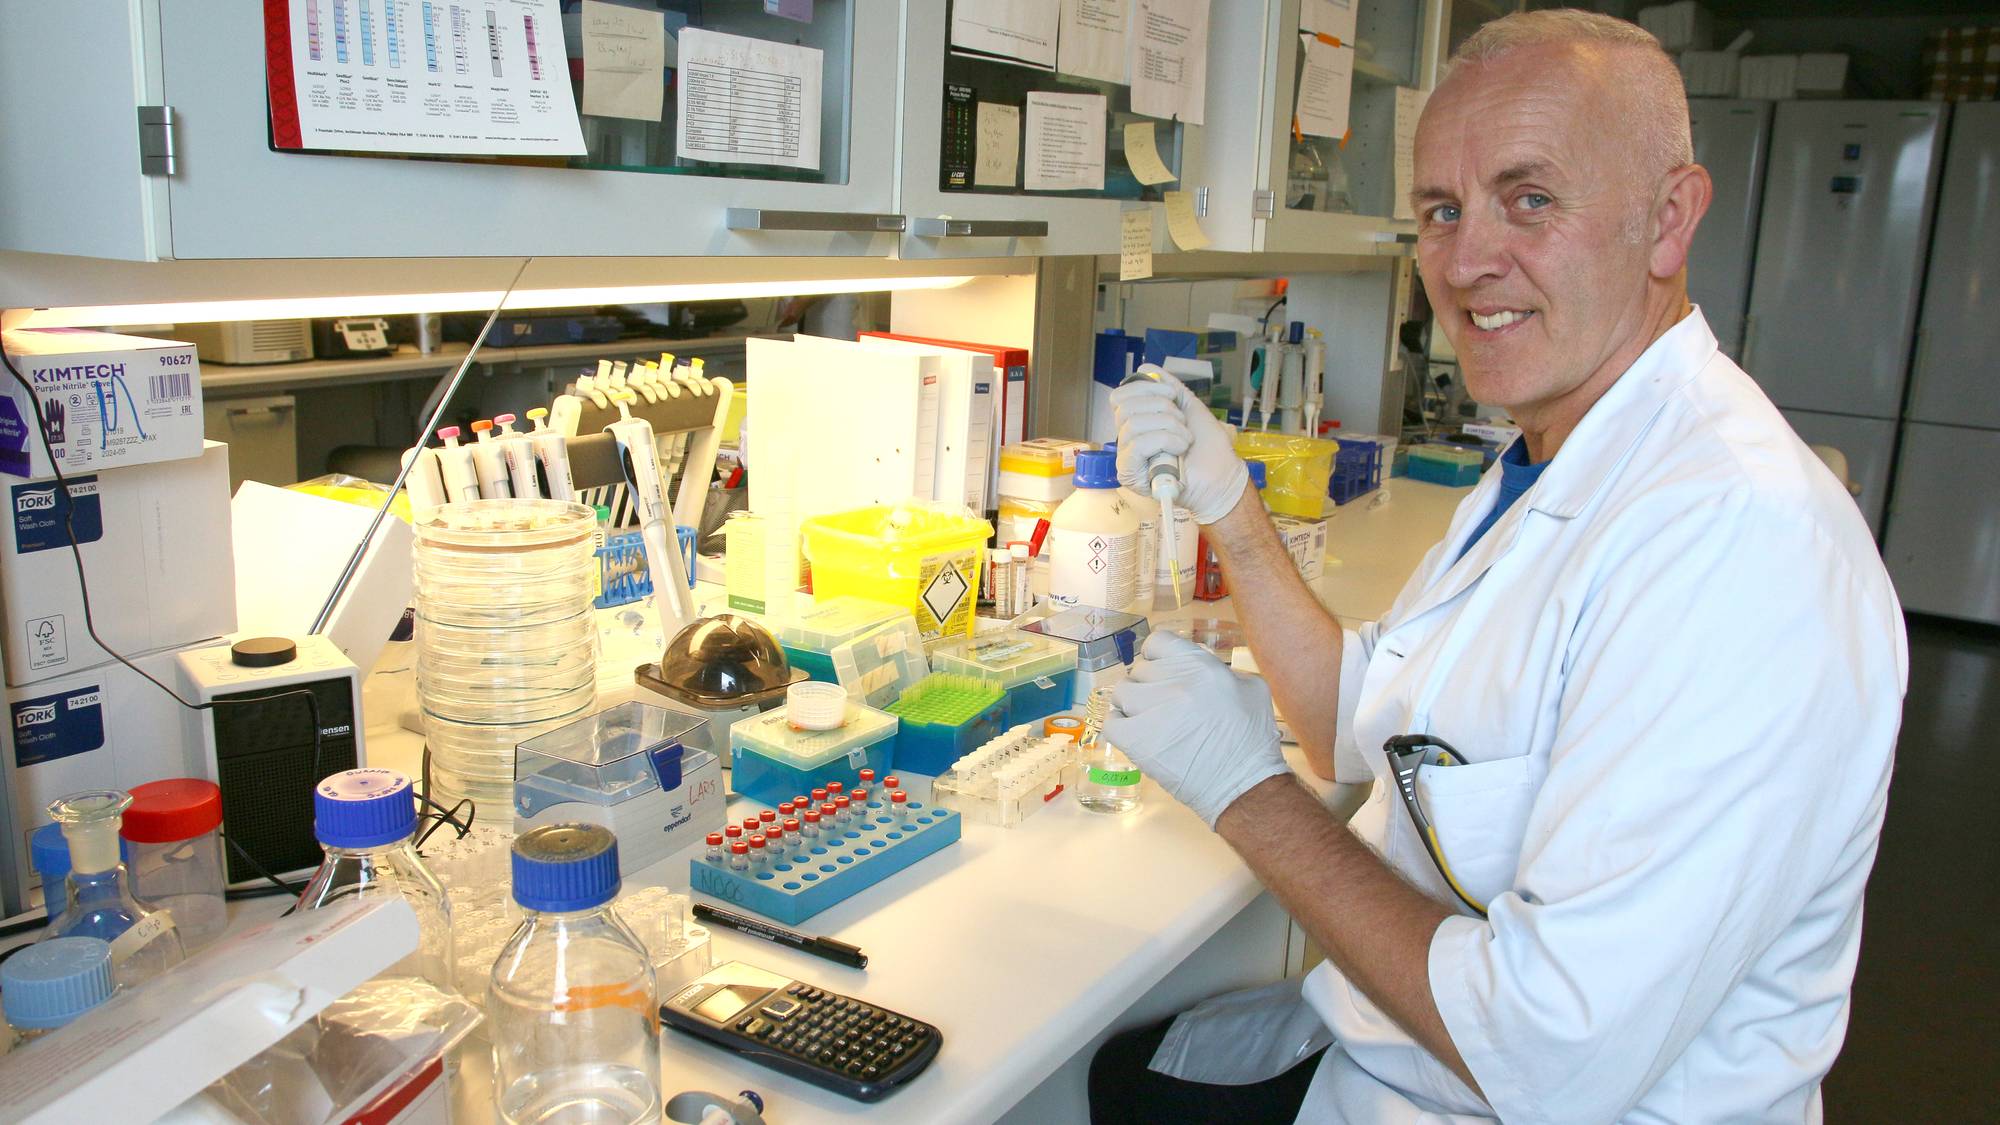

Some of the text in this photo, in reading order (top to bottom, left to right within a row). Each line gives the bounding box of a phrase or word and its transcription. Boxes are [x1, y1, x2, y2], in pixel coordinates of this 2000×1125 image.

[160, 354, 192, 366] 90627
[33, 363, 125, 383] KIMTECH
[35, 385, 61, 394] Purple
[51, 421, 60, 432] M
[19, 495, 53, 509] TORK
[18, 515, 32, 523] Soft
[19, 519, 56, 530] Wash Cloth
[39, 638, 55, 646] FSC
[18, 709, 53, 725] TORK
[38, 731, 56, 742] Cloth
[663, 812, 692, 833] eppendorf
